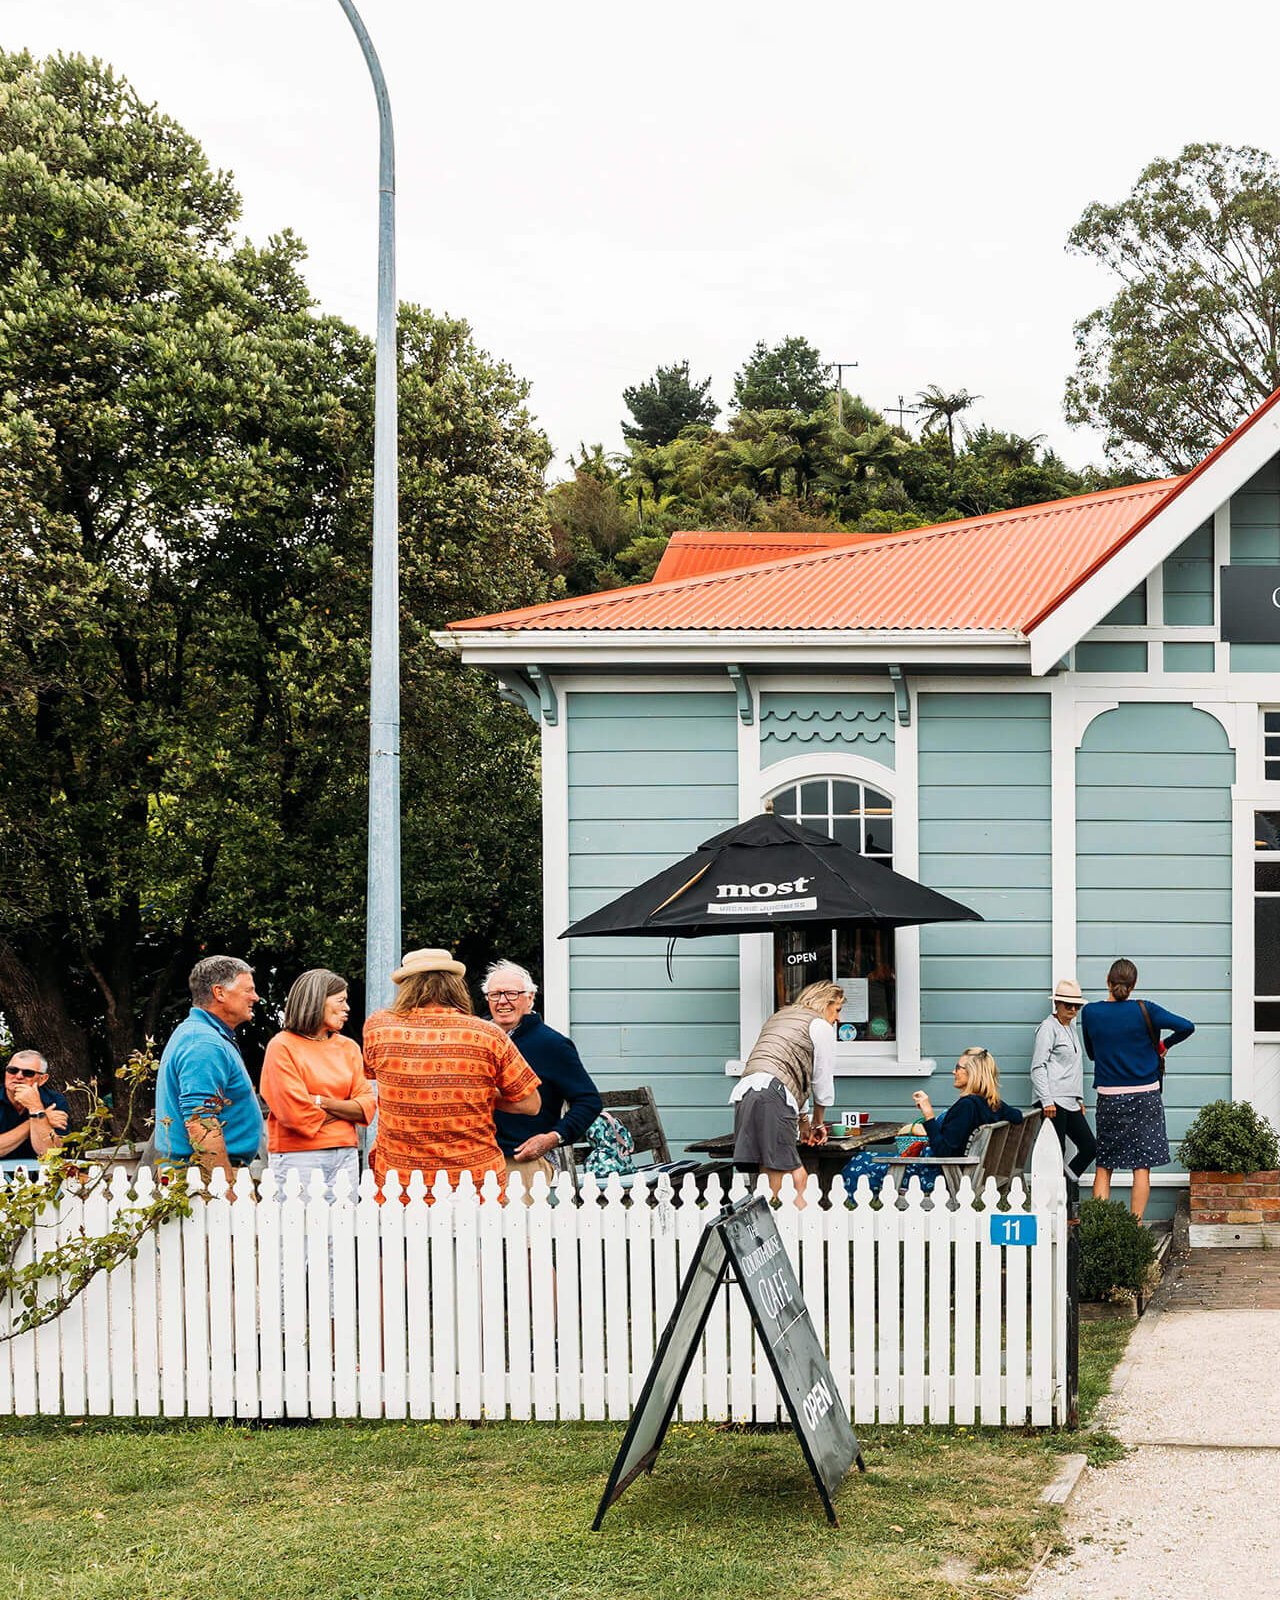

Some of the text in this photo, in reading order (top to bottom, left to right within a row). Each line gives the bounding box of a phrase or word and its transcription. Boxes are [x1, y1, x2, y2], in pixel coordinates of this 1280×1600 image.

[716, 877, 810, 898] most
[787, 952, 817, 965] OPEN
[846, 1115, 857, 1126] 19
[1002, 1219, 1020, 1241] 11
[741, 1234, 782, 1278] COURTHOUSE
[758, 1267, 793, 1319] CAFE
[803, 1376, 834, 1431] OPEN
